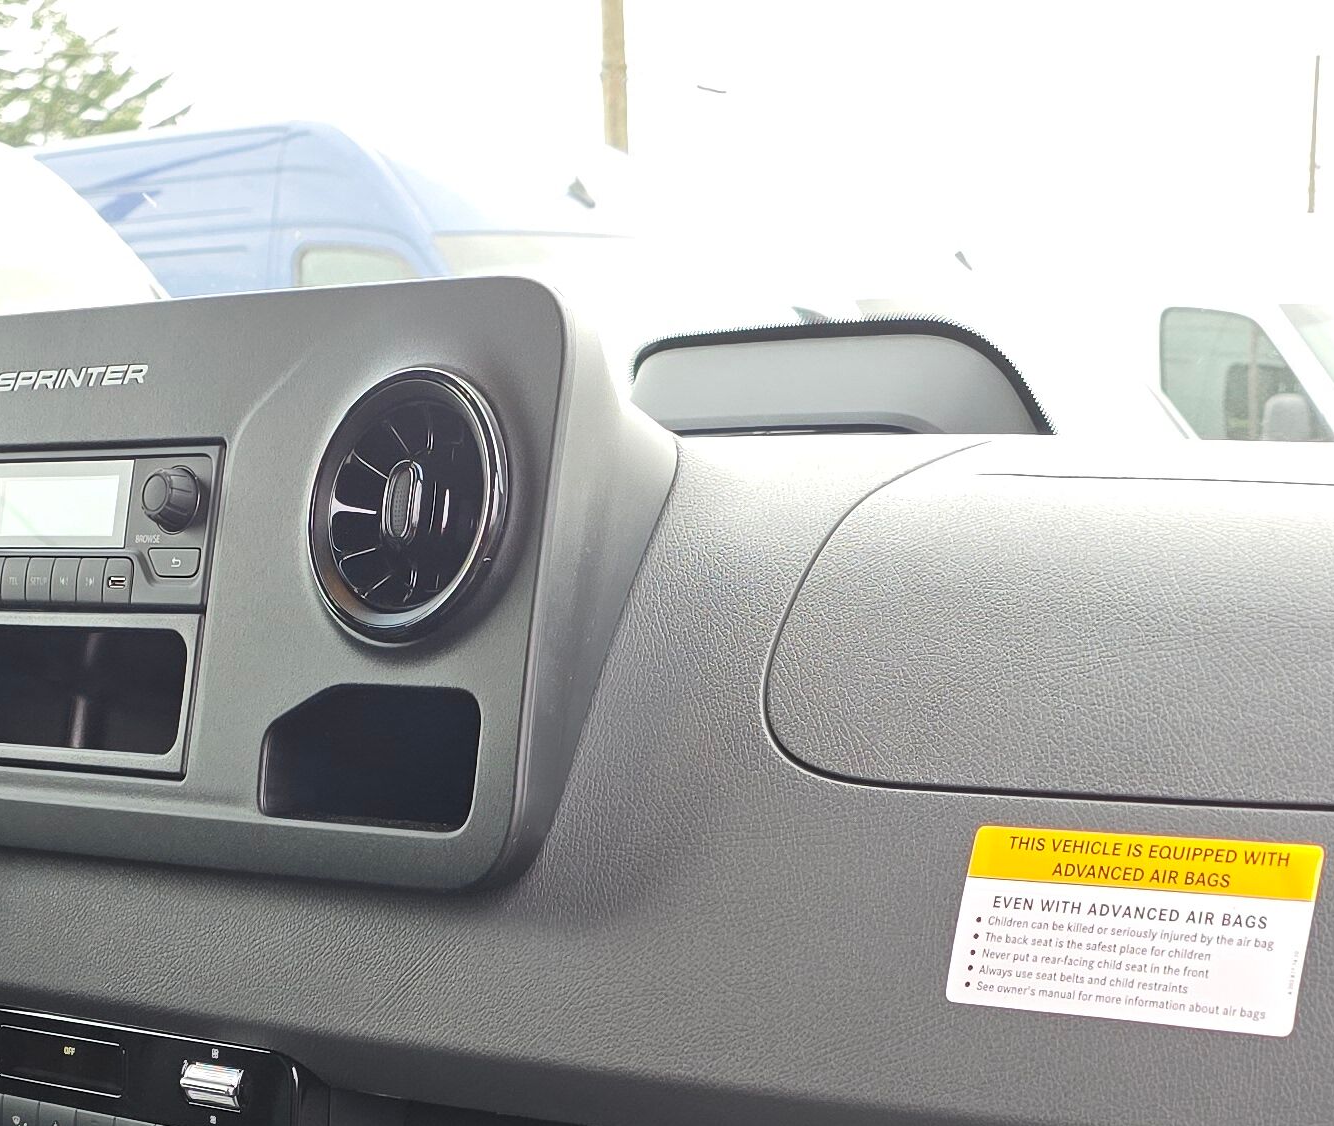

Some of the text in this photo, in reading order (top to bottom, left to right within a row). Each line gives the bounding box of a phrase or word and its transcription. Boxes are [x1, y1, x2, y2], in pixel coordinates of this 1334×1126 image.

[135, 534, 161, 544] BROWSE
[1009, 835, 1291, 867] THIS VEHICLE IS EQUIPPED WITH
[1051, 862, 1231, 889] ADVANCED AIR BAGS
[992, 895, 1268, 930] EVEN WITH ADVANCED AIR BAGS
[985, 931, 1212, 961] The back seat is the safest place for children
[987, 915, 1275, 952] Children can be killed or seriously injured by the air bag
[978, 964, 1189, 995] Always use seat belts and child restraints
[981, 948, 1210, 980] Never put a rear-facing child seat in the front
[976, 980, 1266, 1022] See owner's manual for more information about air bags
